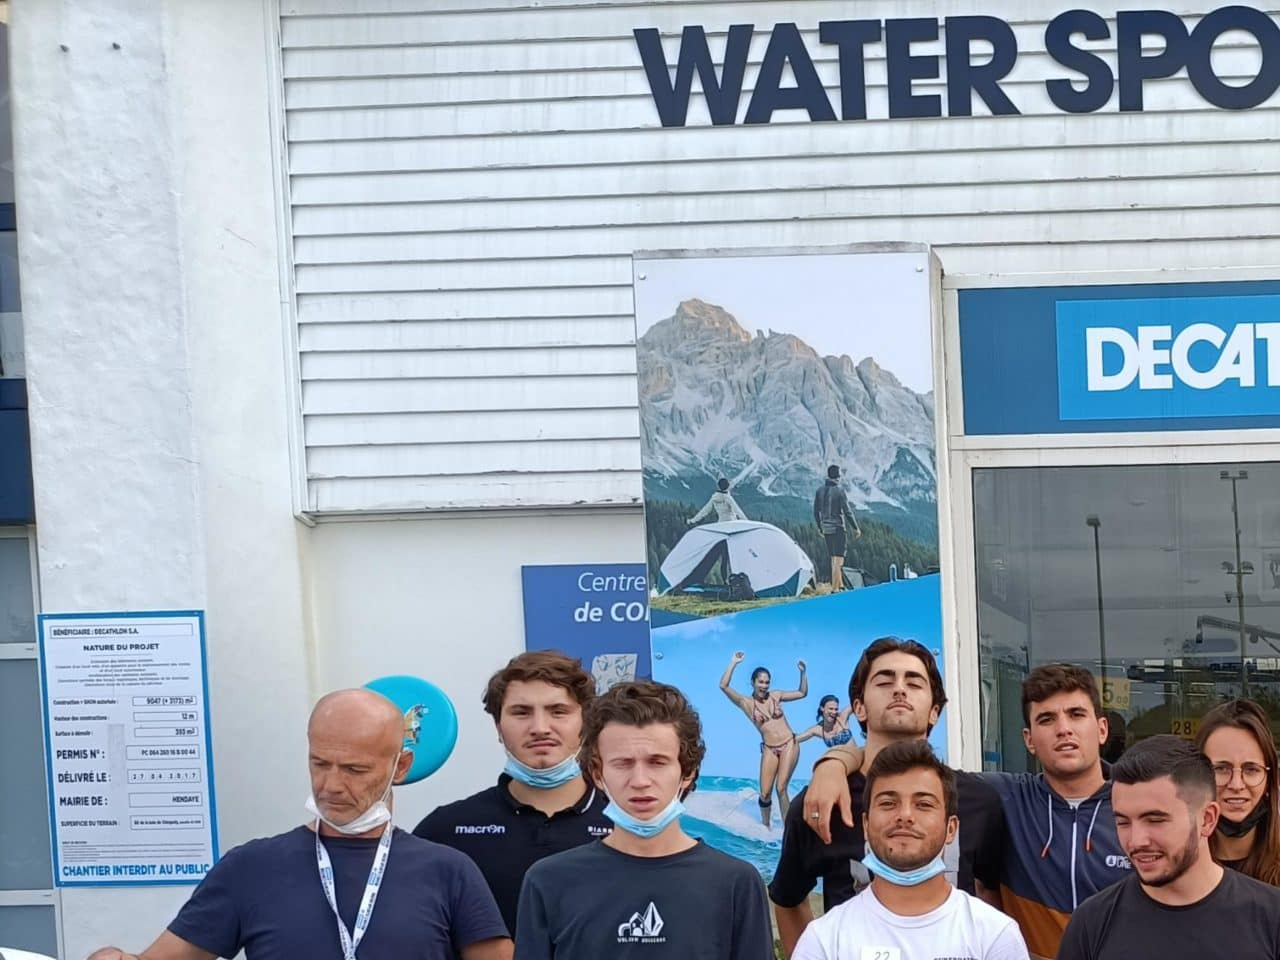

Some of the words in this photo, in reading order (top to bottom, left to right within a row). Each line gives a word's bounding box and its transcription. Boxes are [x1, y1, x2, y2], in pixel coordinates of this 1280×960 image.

[634, 16, 1021, 127] WATER
[578, 572, 646, 592] Centre
[574, 602, 603, 622] de
[129, 642, 160, 650] PROJET
[1173, 720, 1192, 735] 28
[57, 749, 88, 759] PERMIS
[58, 770, 94, 783] DÉLIVRÉ
[96, 772, 107, 783] LE
[59, 796, 89, 806] MAIRIE
[91, 796, 103, 806] DE
[62, 864, 110, 877] CHANTIER
[112, 863, 157, 876] INTERDIT
[159, 863, 174, 875] AU
[176, 862, 209, 875] PUBLIC
